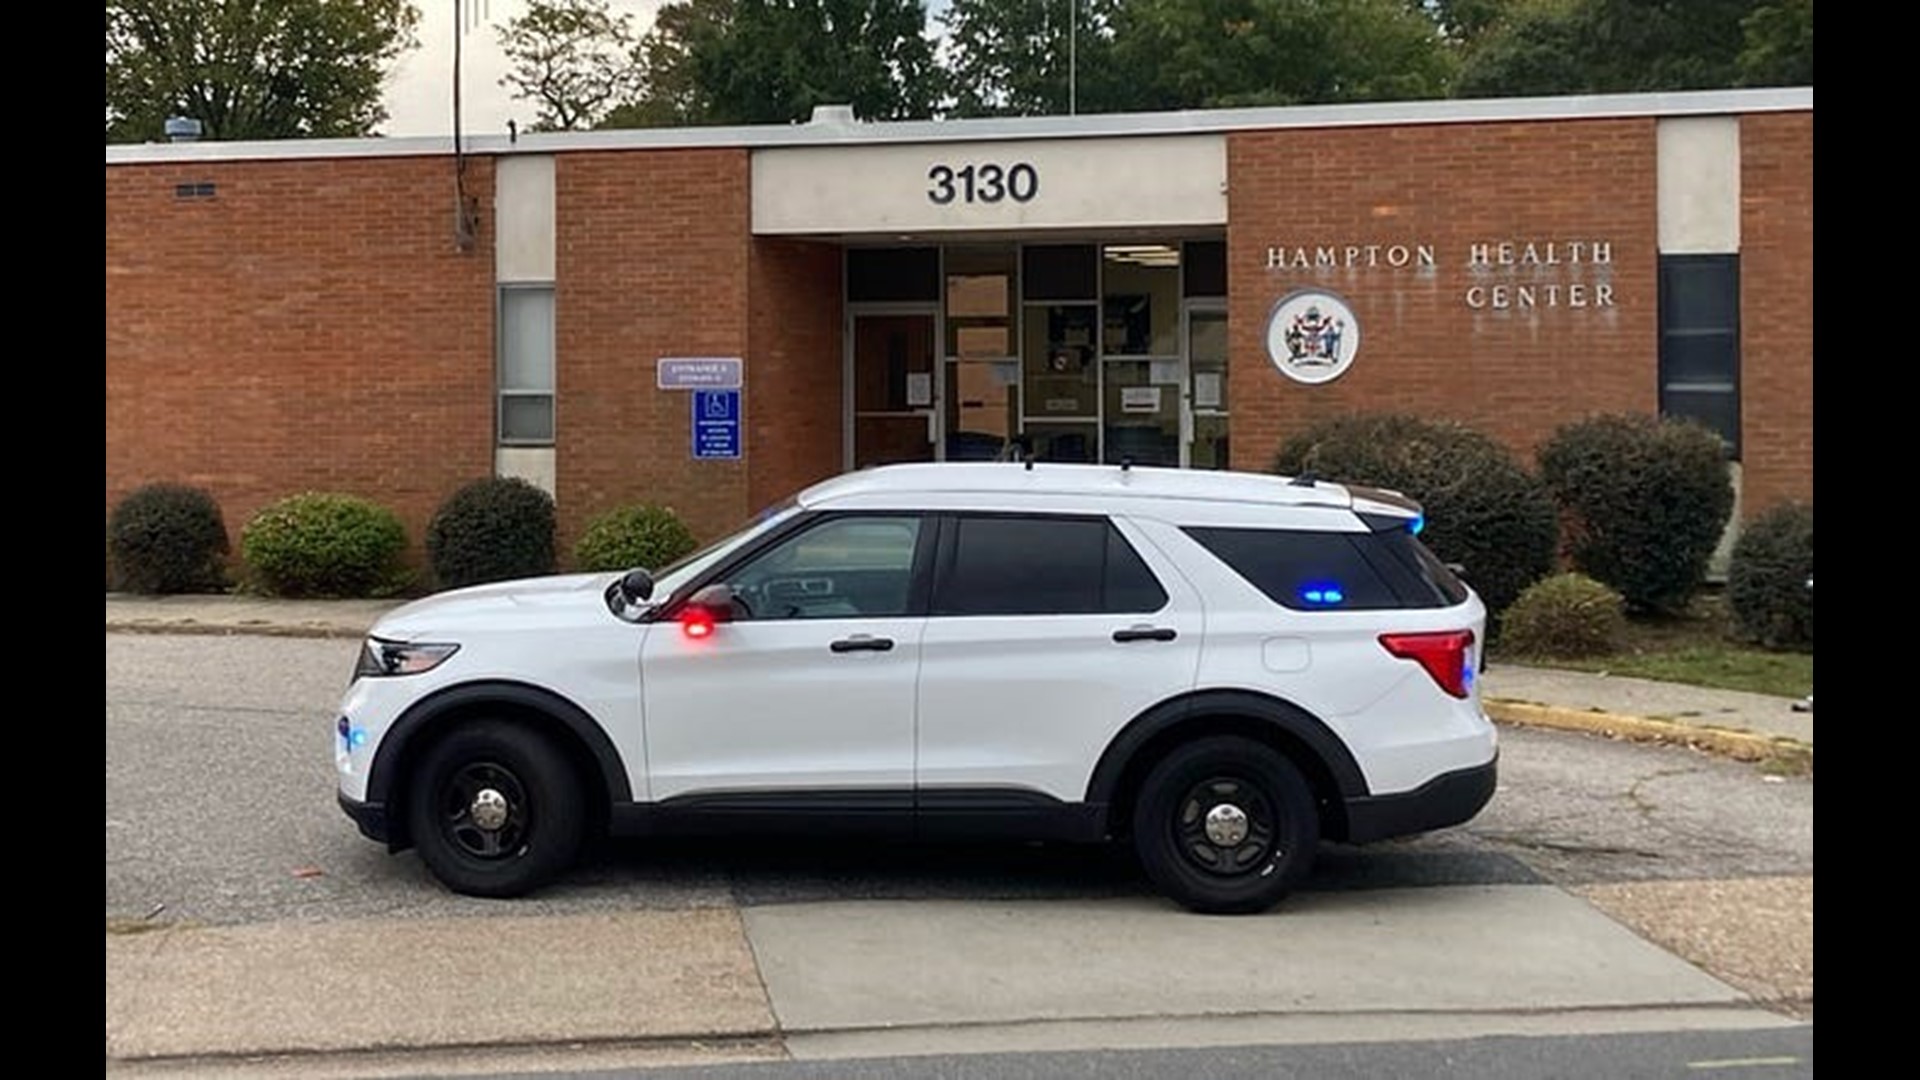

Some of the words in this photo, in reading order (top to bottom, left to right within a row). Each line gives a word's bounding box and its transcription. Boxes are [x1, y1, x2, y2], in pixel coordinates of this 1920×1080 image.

[928, 163, 1039, 204] 3130
[1267, 246, 1436, 268] HAMPTON
[1470, 243, 1612, 265] HEALTH
[1466, 285, 1616, 309] CENTER
